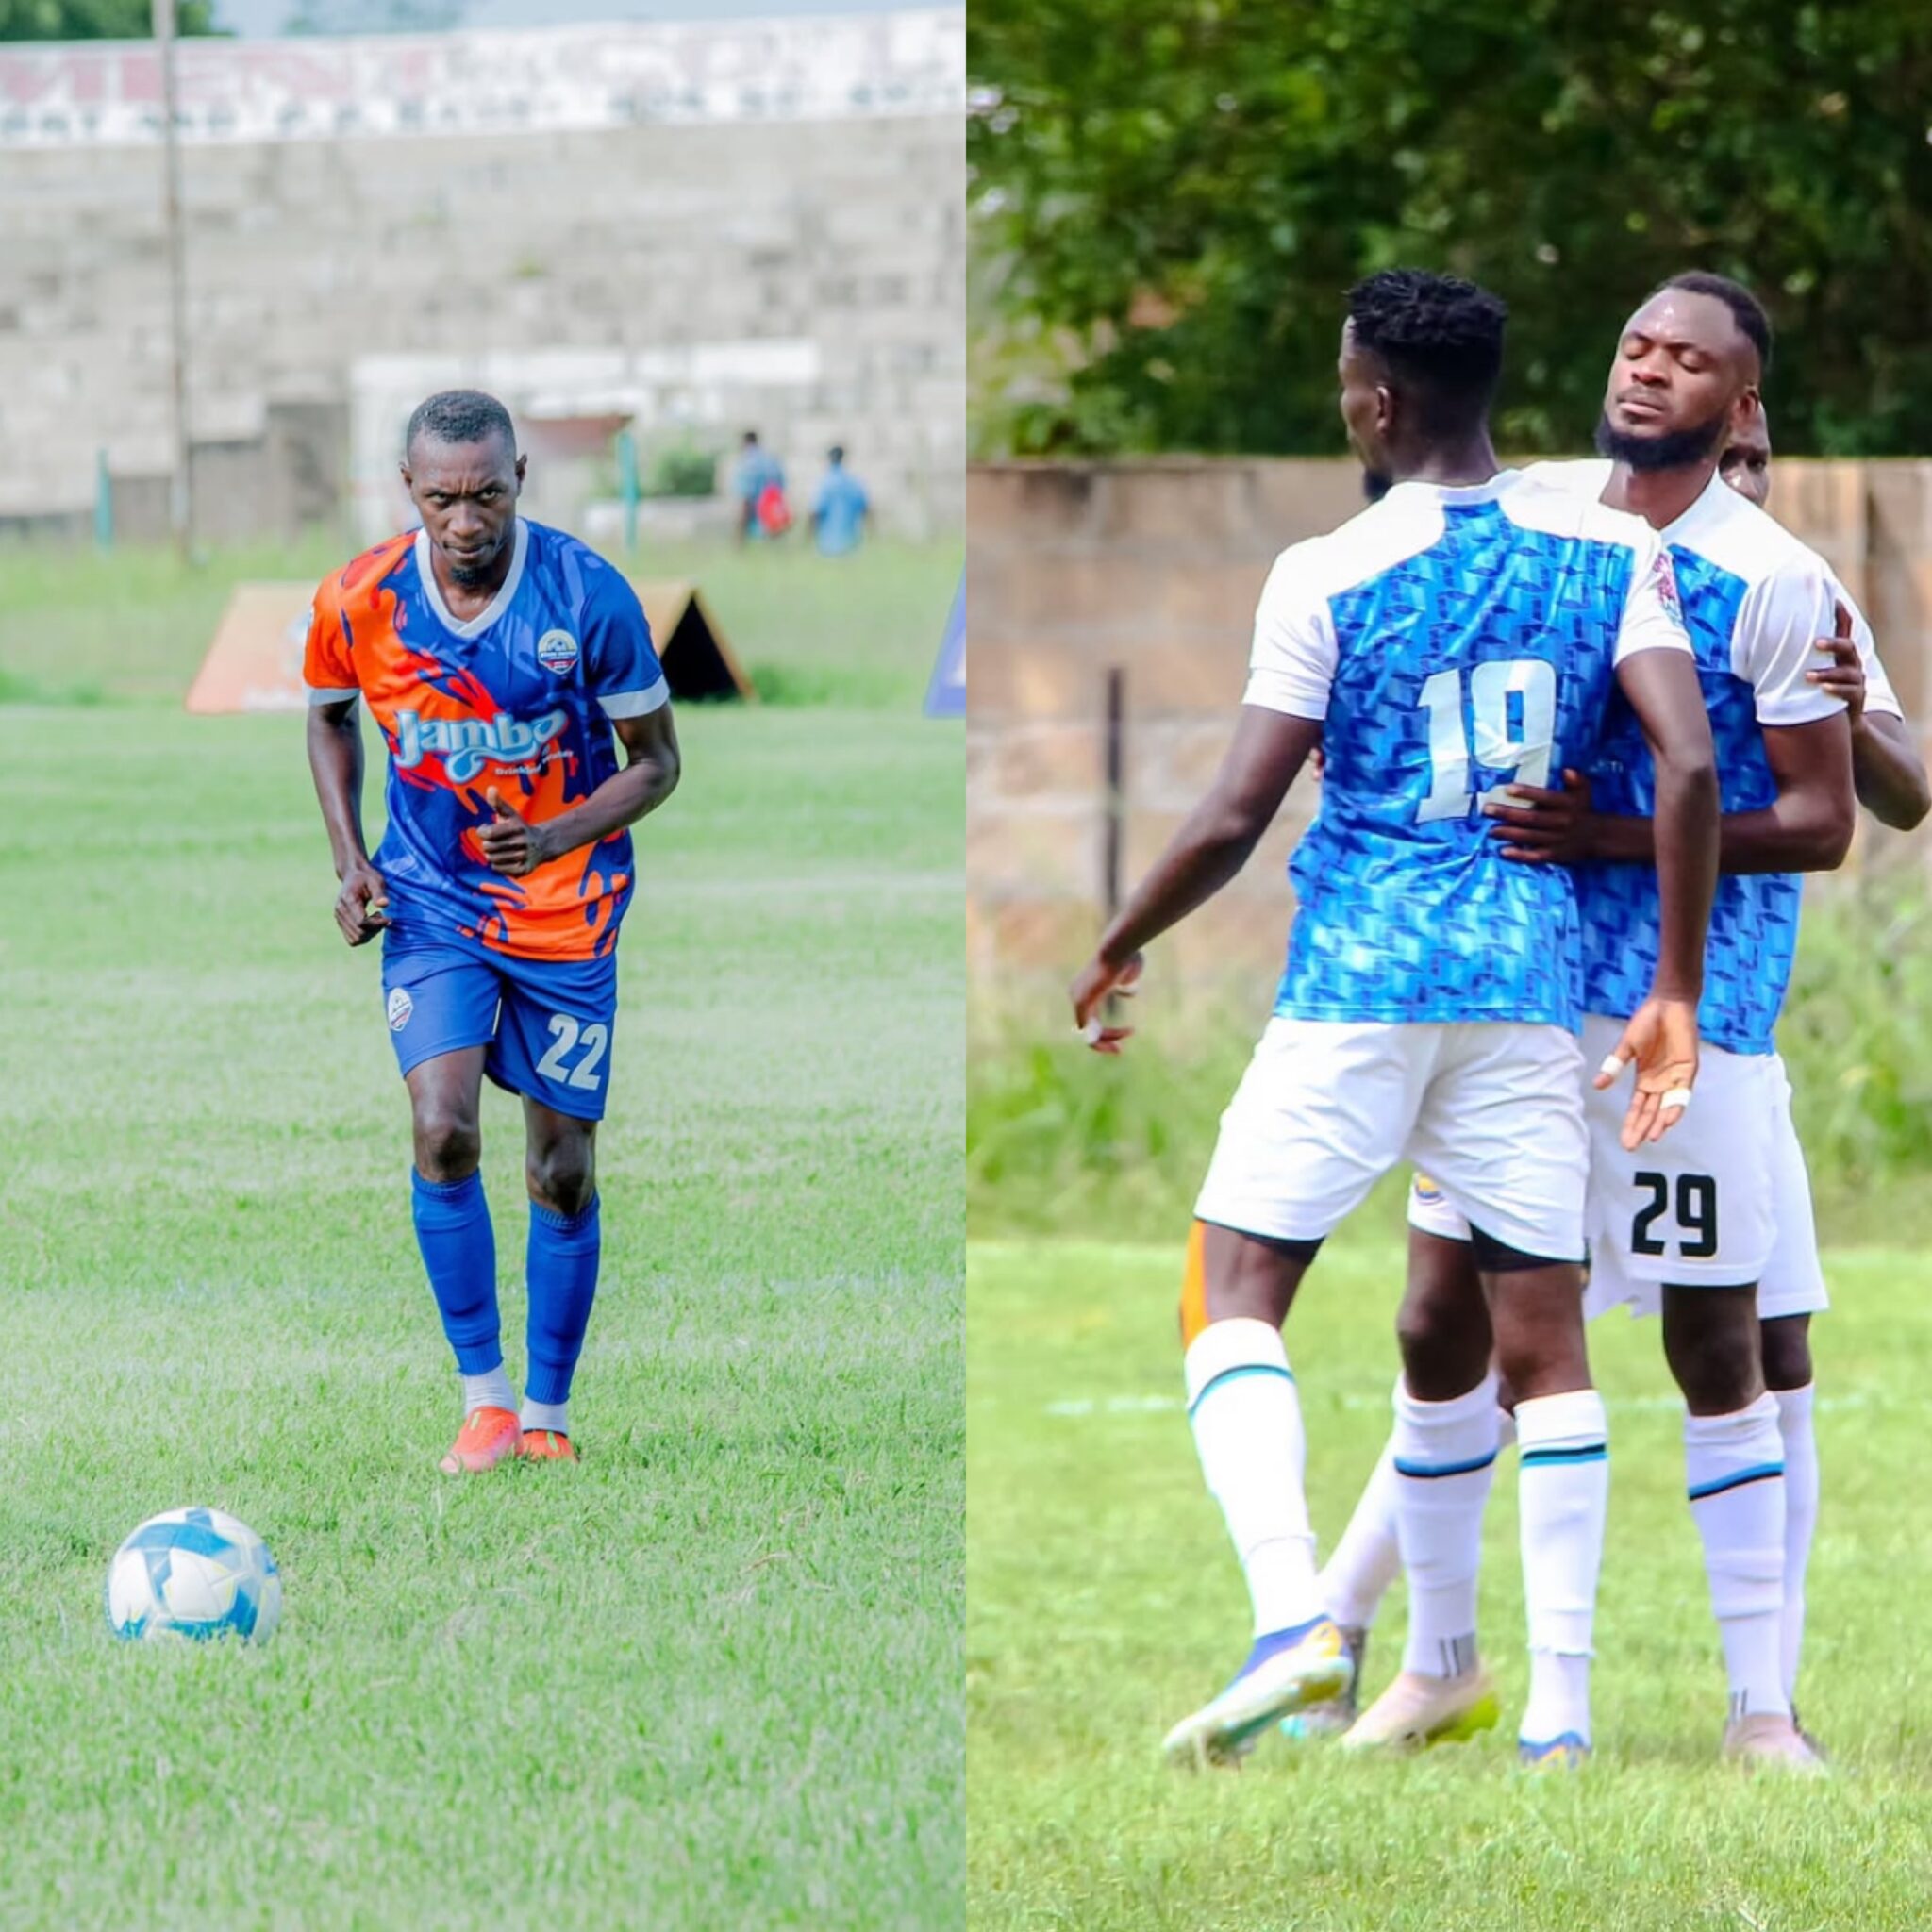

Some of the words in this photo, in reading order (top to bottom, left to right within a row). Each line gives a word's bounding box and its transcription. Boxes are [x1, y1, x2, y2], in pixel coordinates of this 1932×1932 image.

[393, 709, 568, 783] Jambo
[1415, 659, 1557, 824] 19
[535, 1013, 608, 1091] 22
[1631, 1171, 1717, 1258] 29
